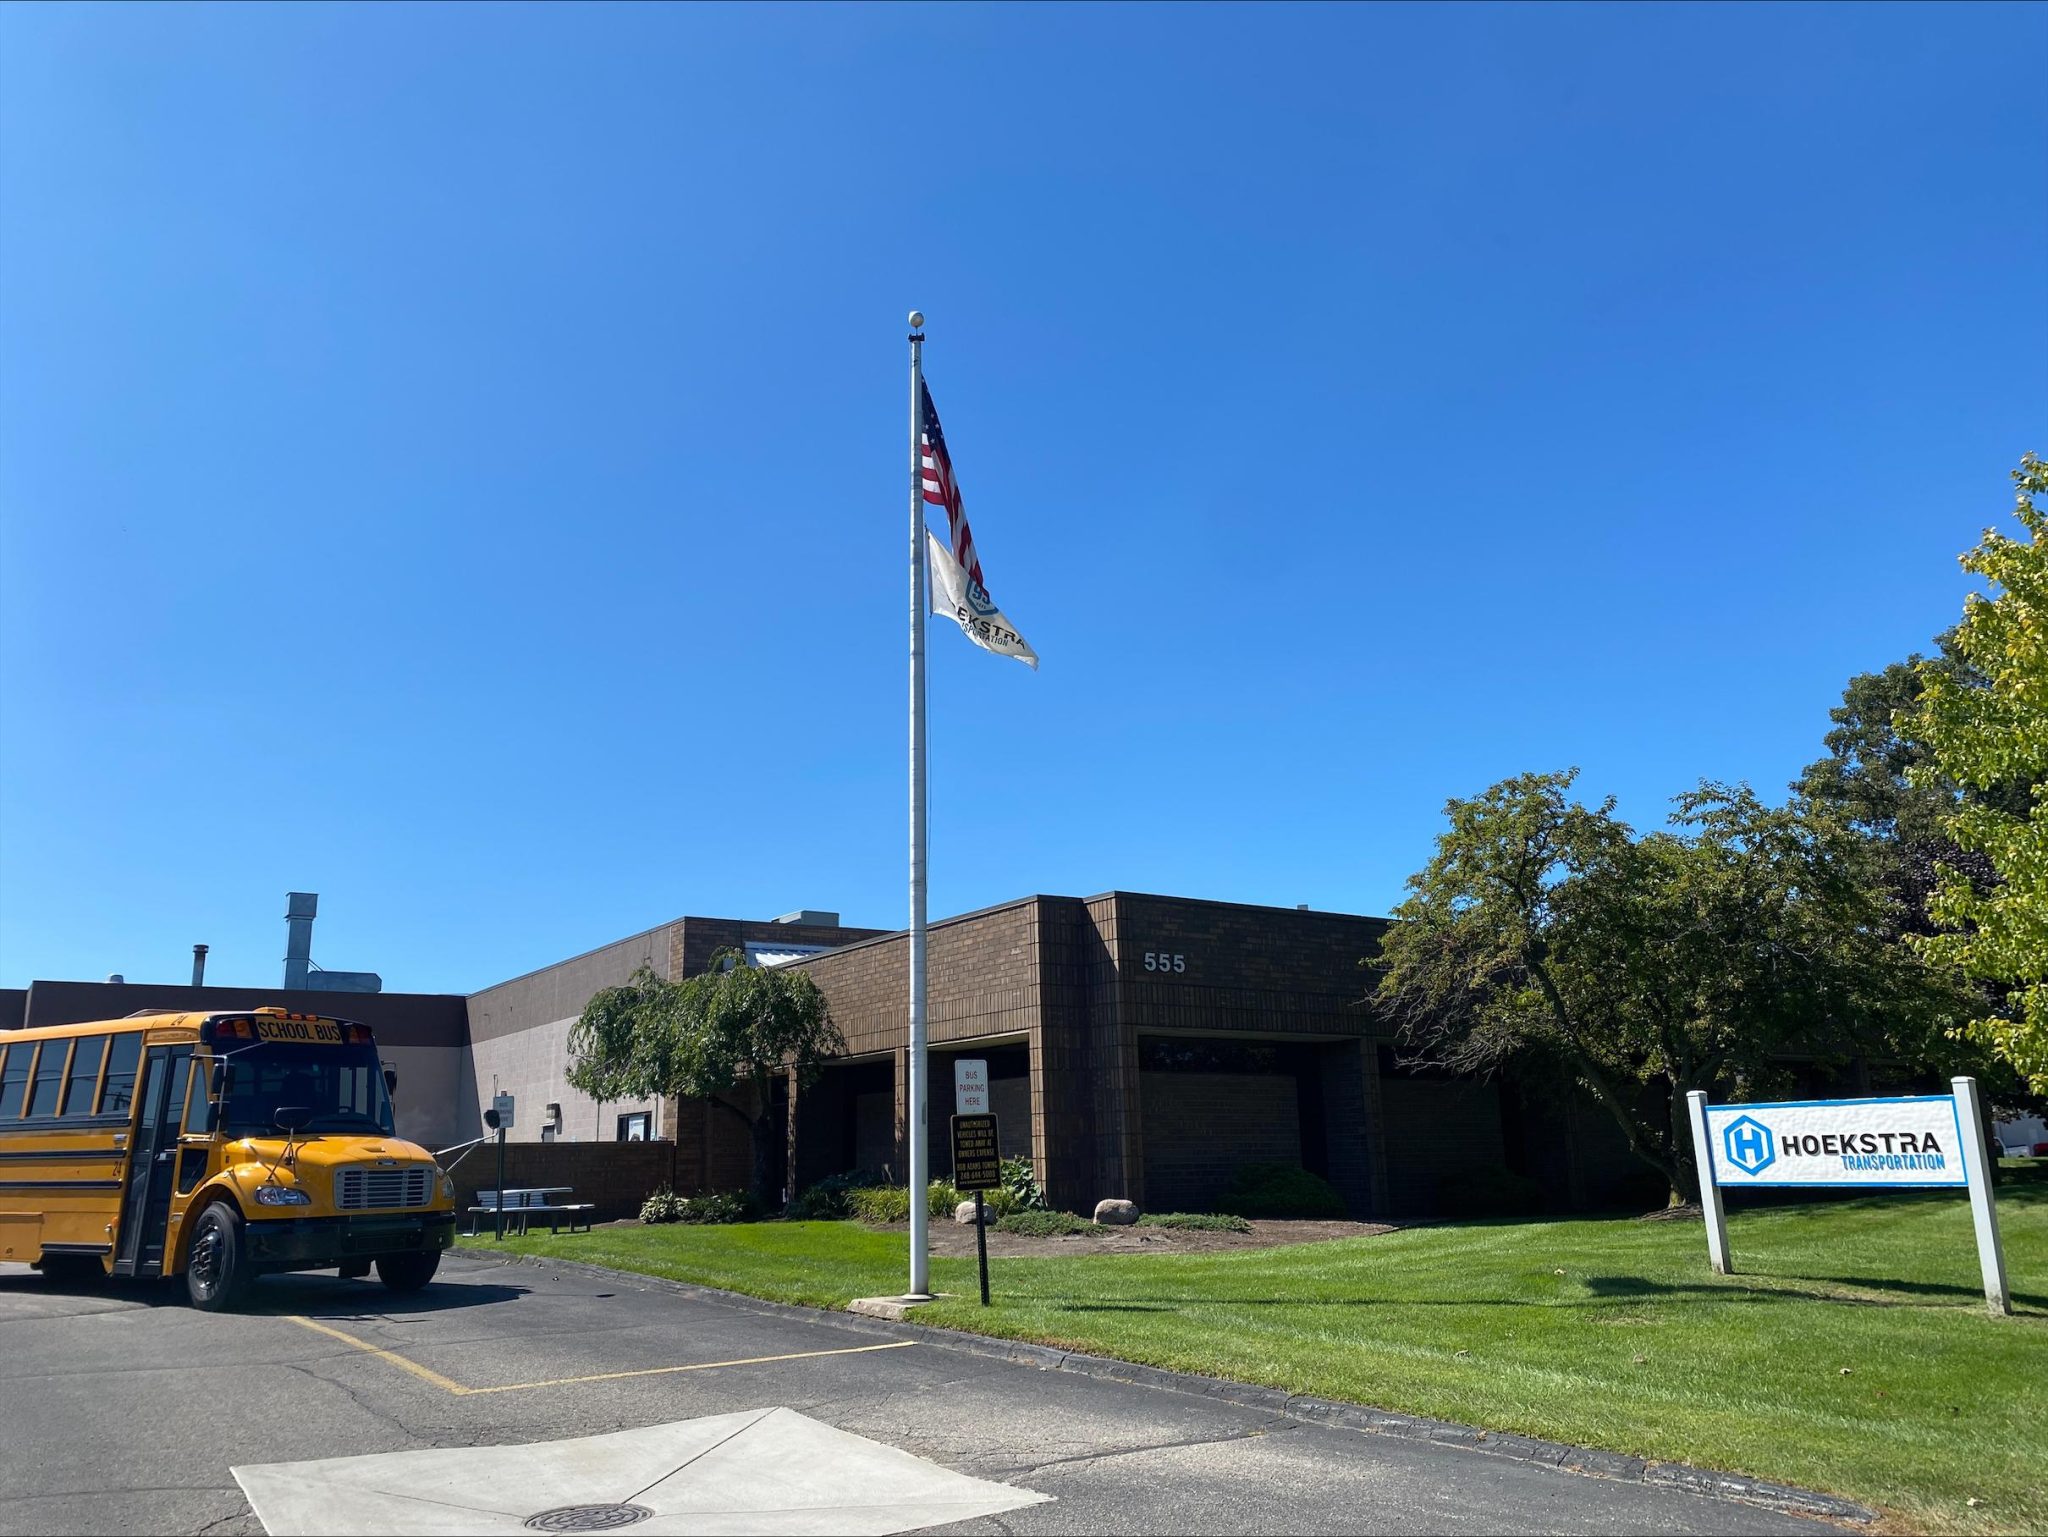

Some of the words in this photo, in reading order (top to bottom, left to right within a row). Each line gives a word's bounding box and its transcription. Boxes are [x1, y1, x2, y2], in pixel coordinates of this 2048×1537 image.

[957, 605, 1025, 649] EKSTRA
[1144, 952, 1186, 973] 555
[258, 1022, 314, 1040] SCHOOL
[314, 1025, 341, 1041] BUS
[965, 1070, 978, 1079] BUS
[959, 1084, 985, 1093] PARKING
[965, 1097, 980, 1106] HERE
[1781, 1132, 1944, 1157] HOEKSTRA
[112, 1160, 122, 1177] 24
[1842, 1153, 1946, 1171] TRANSPORTATION
